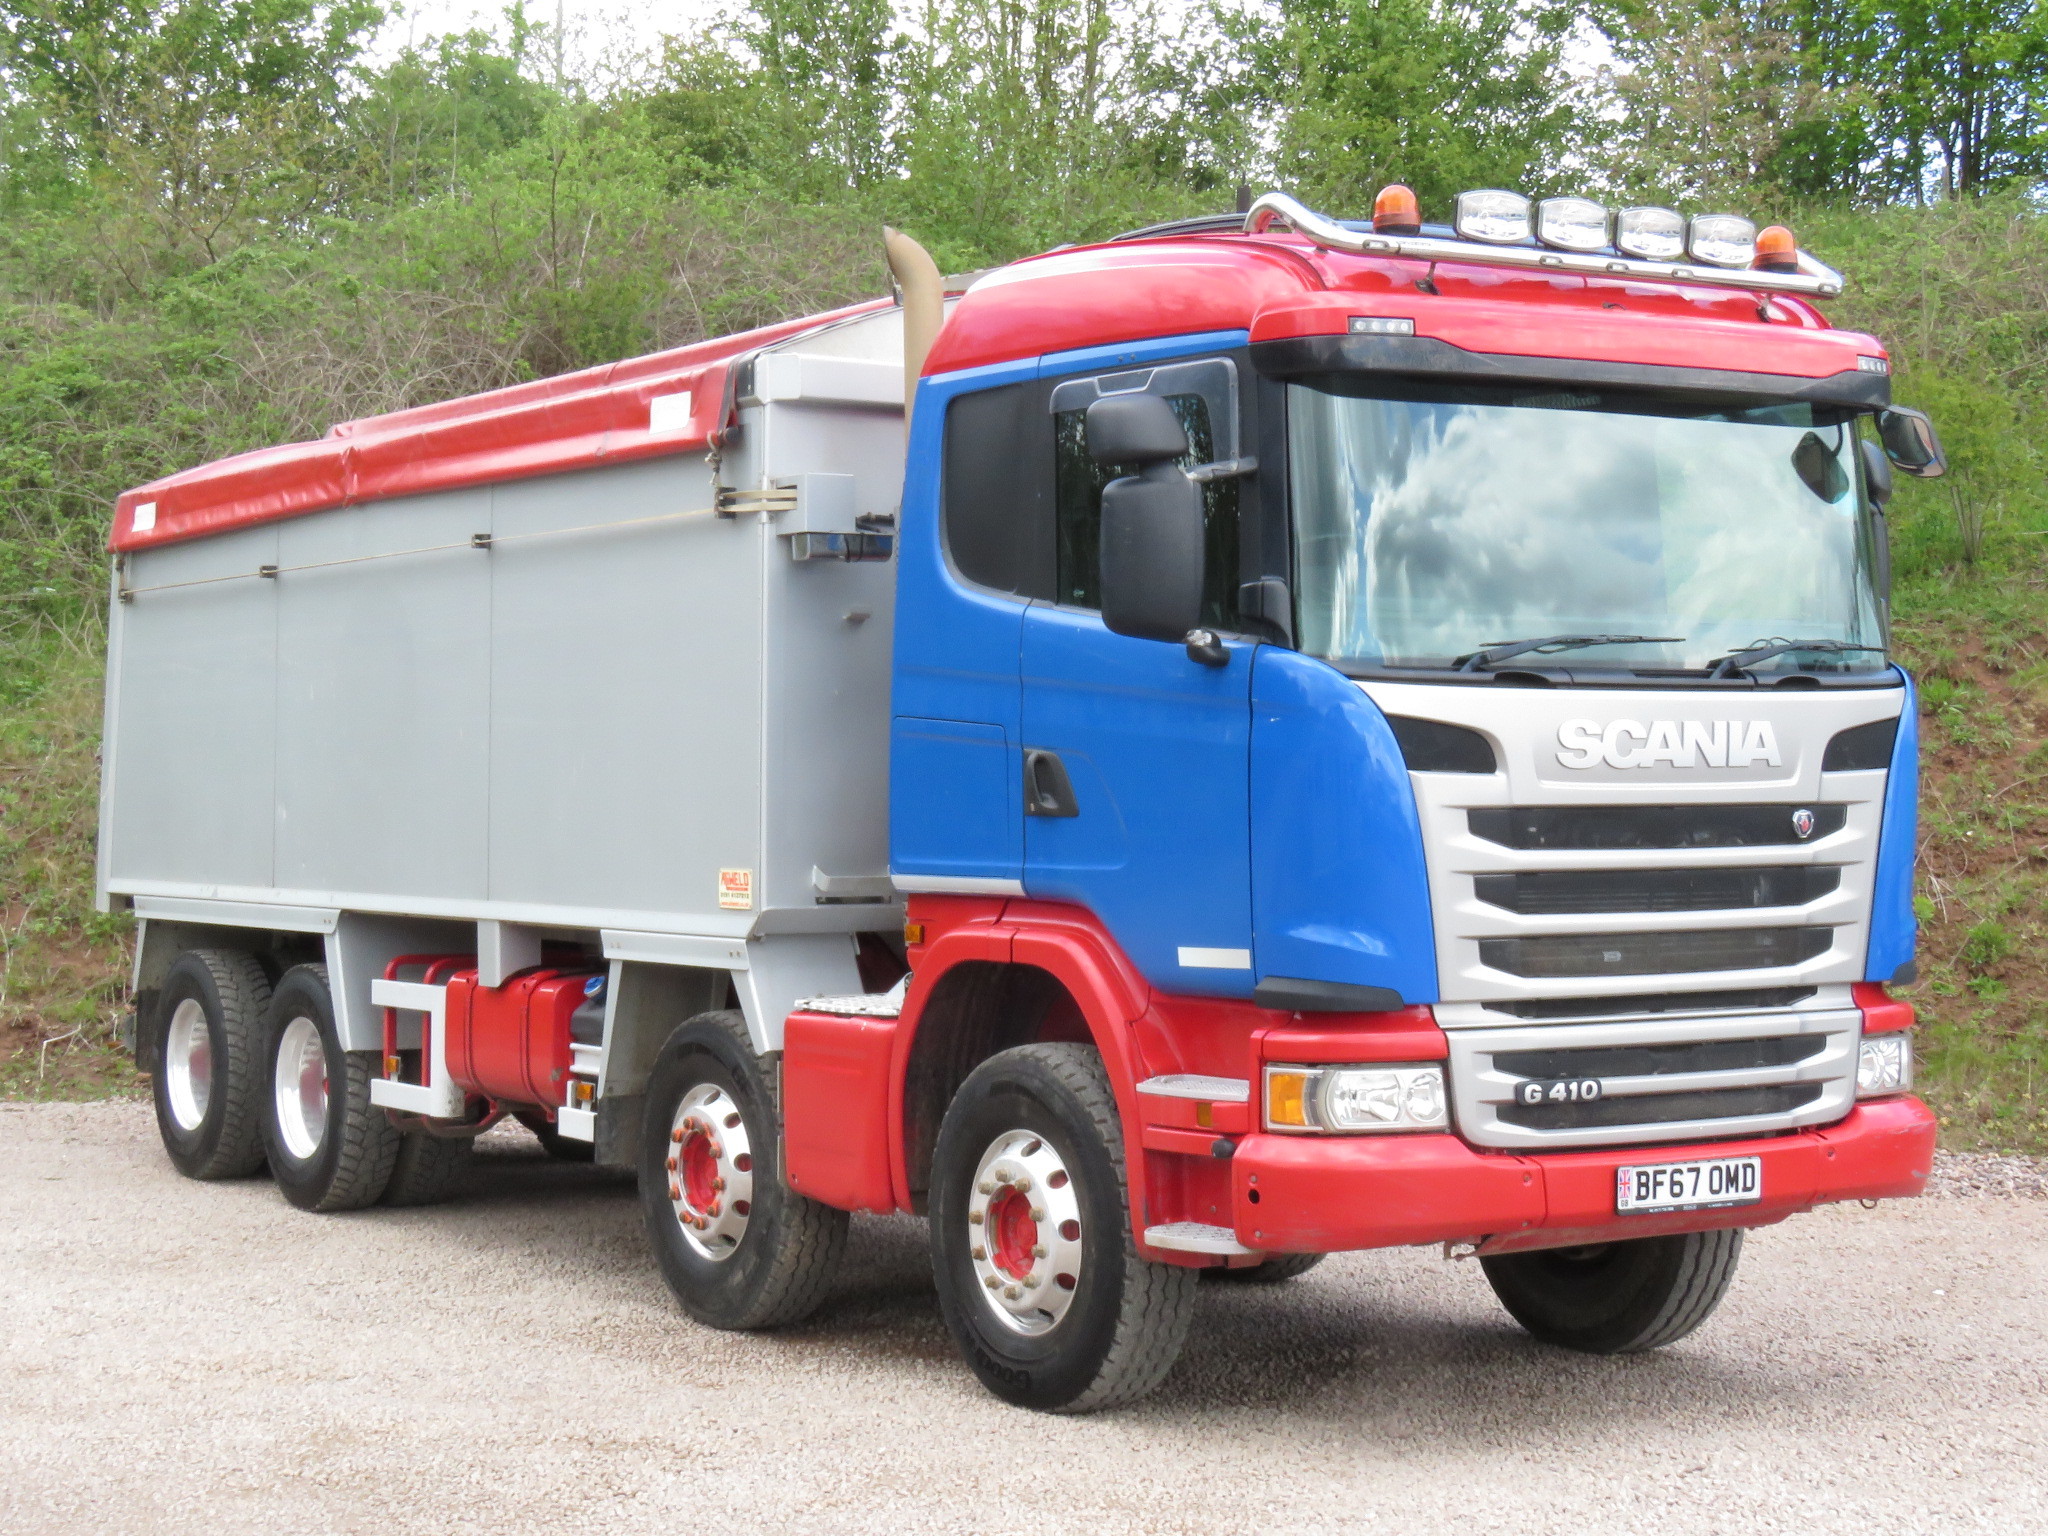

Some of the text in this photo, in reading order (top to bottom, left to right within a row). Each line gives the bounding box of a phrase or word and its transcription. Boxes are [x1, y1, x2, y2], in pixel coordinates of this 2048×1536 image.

[1555, 718, 1782, 770] SCANIA
[1524, 1080, 1599, 1104] G 410
[1635, 1163, 1756, 1201] BF67 OMD
[1620, 1199, 1629, 1208] GB
